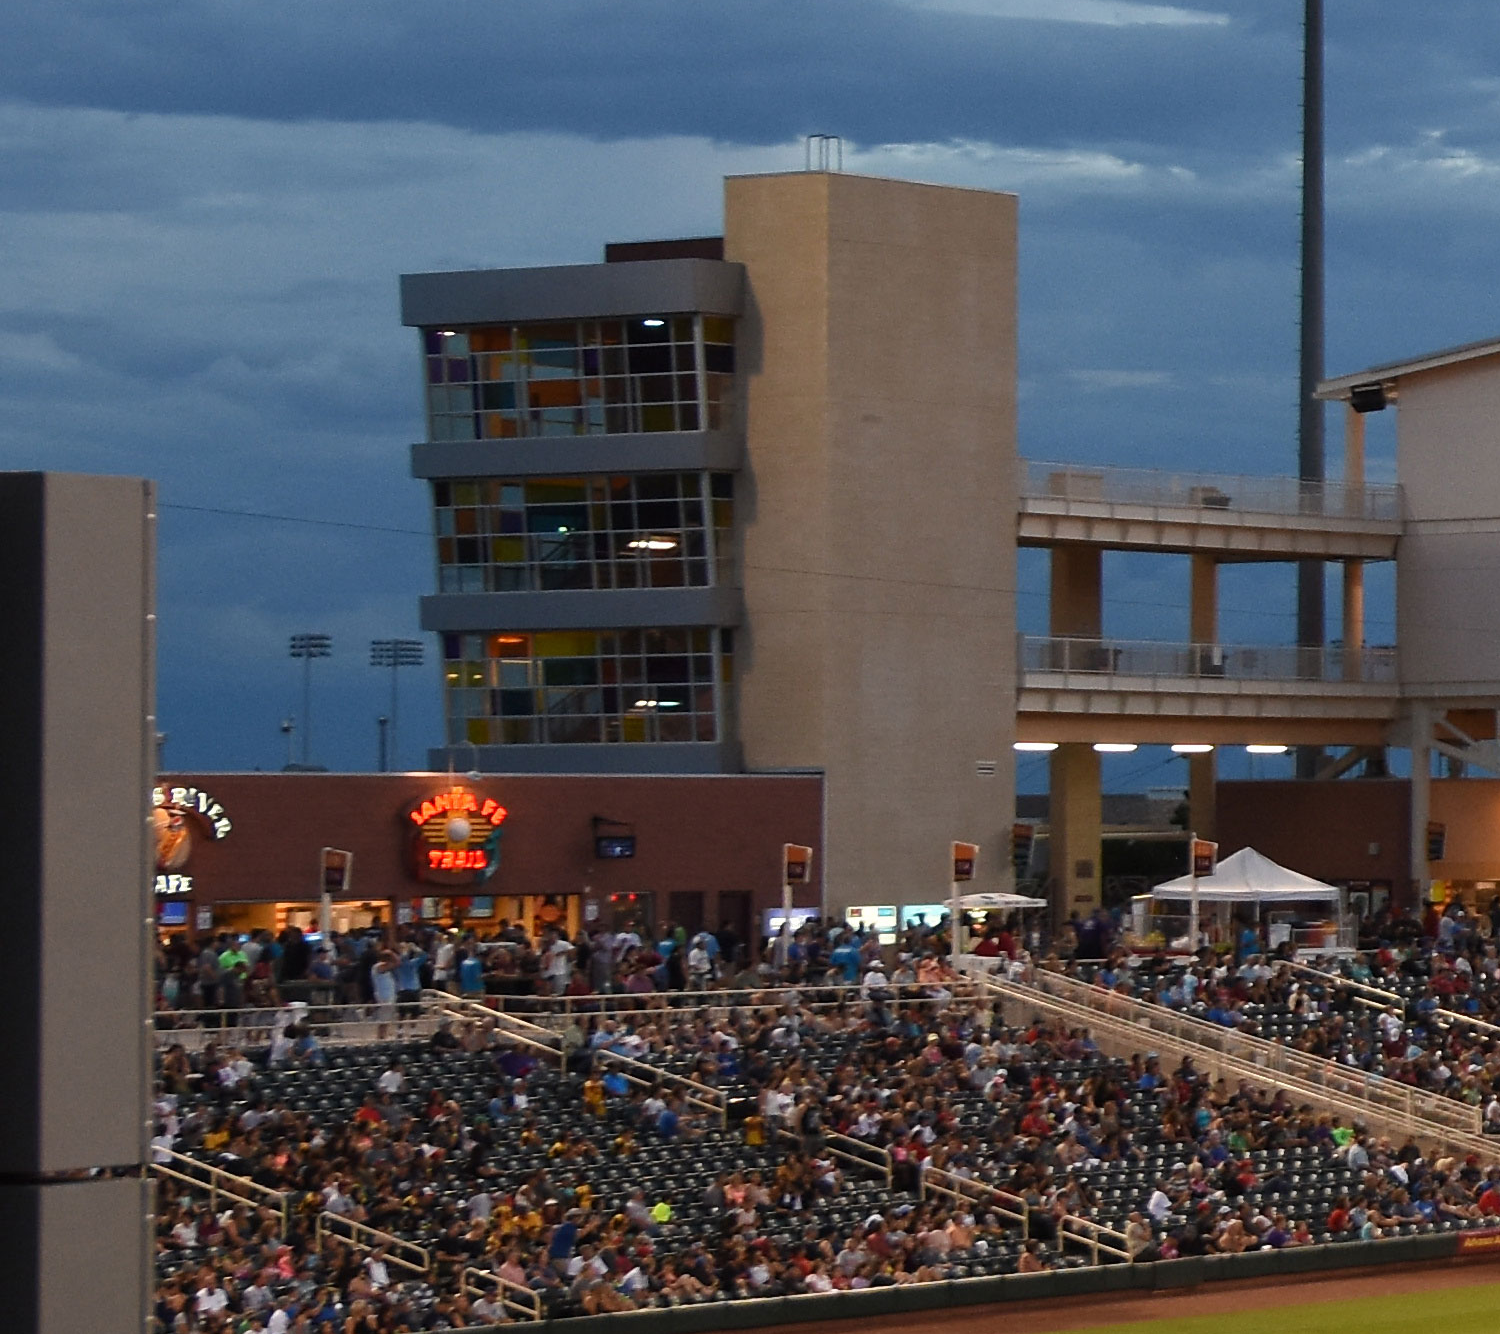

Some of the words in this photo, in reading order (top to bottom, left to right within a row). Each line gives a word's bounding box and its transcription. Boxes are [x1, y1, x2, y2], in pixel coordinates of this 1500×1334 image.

[170, 787, 232, 839] RIVER
[410, 792, 479, 826] SANTA
[481, 798, 508, 826] FE
[428, 849, 487, 869] TRAIL
[154, 874, 193, 894] AFE
